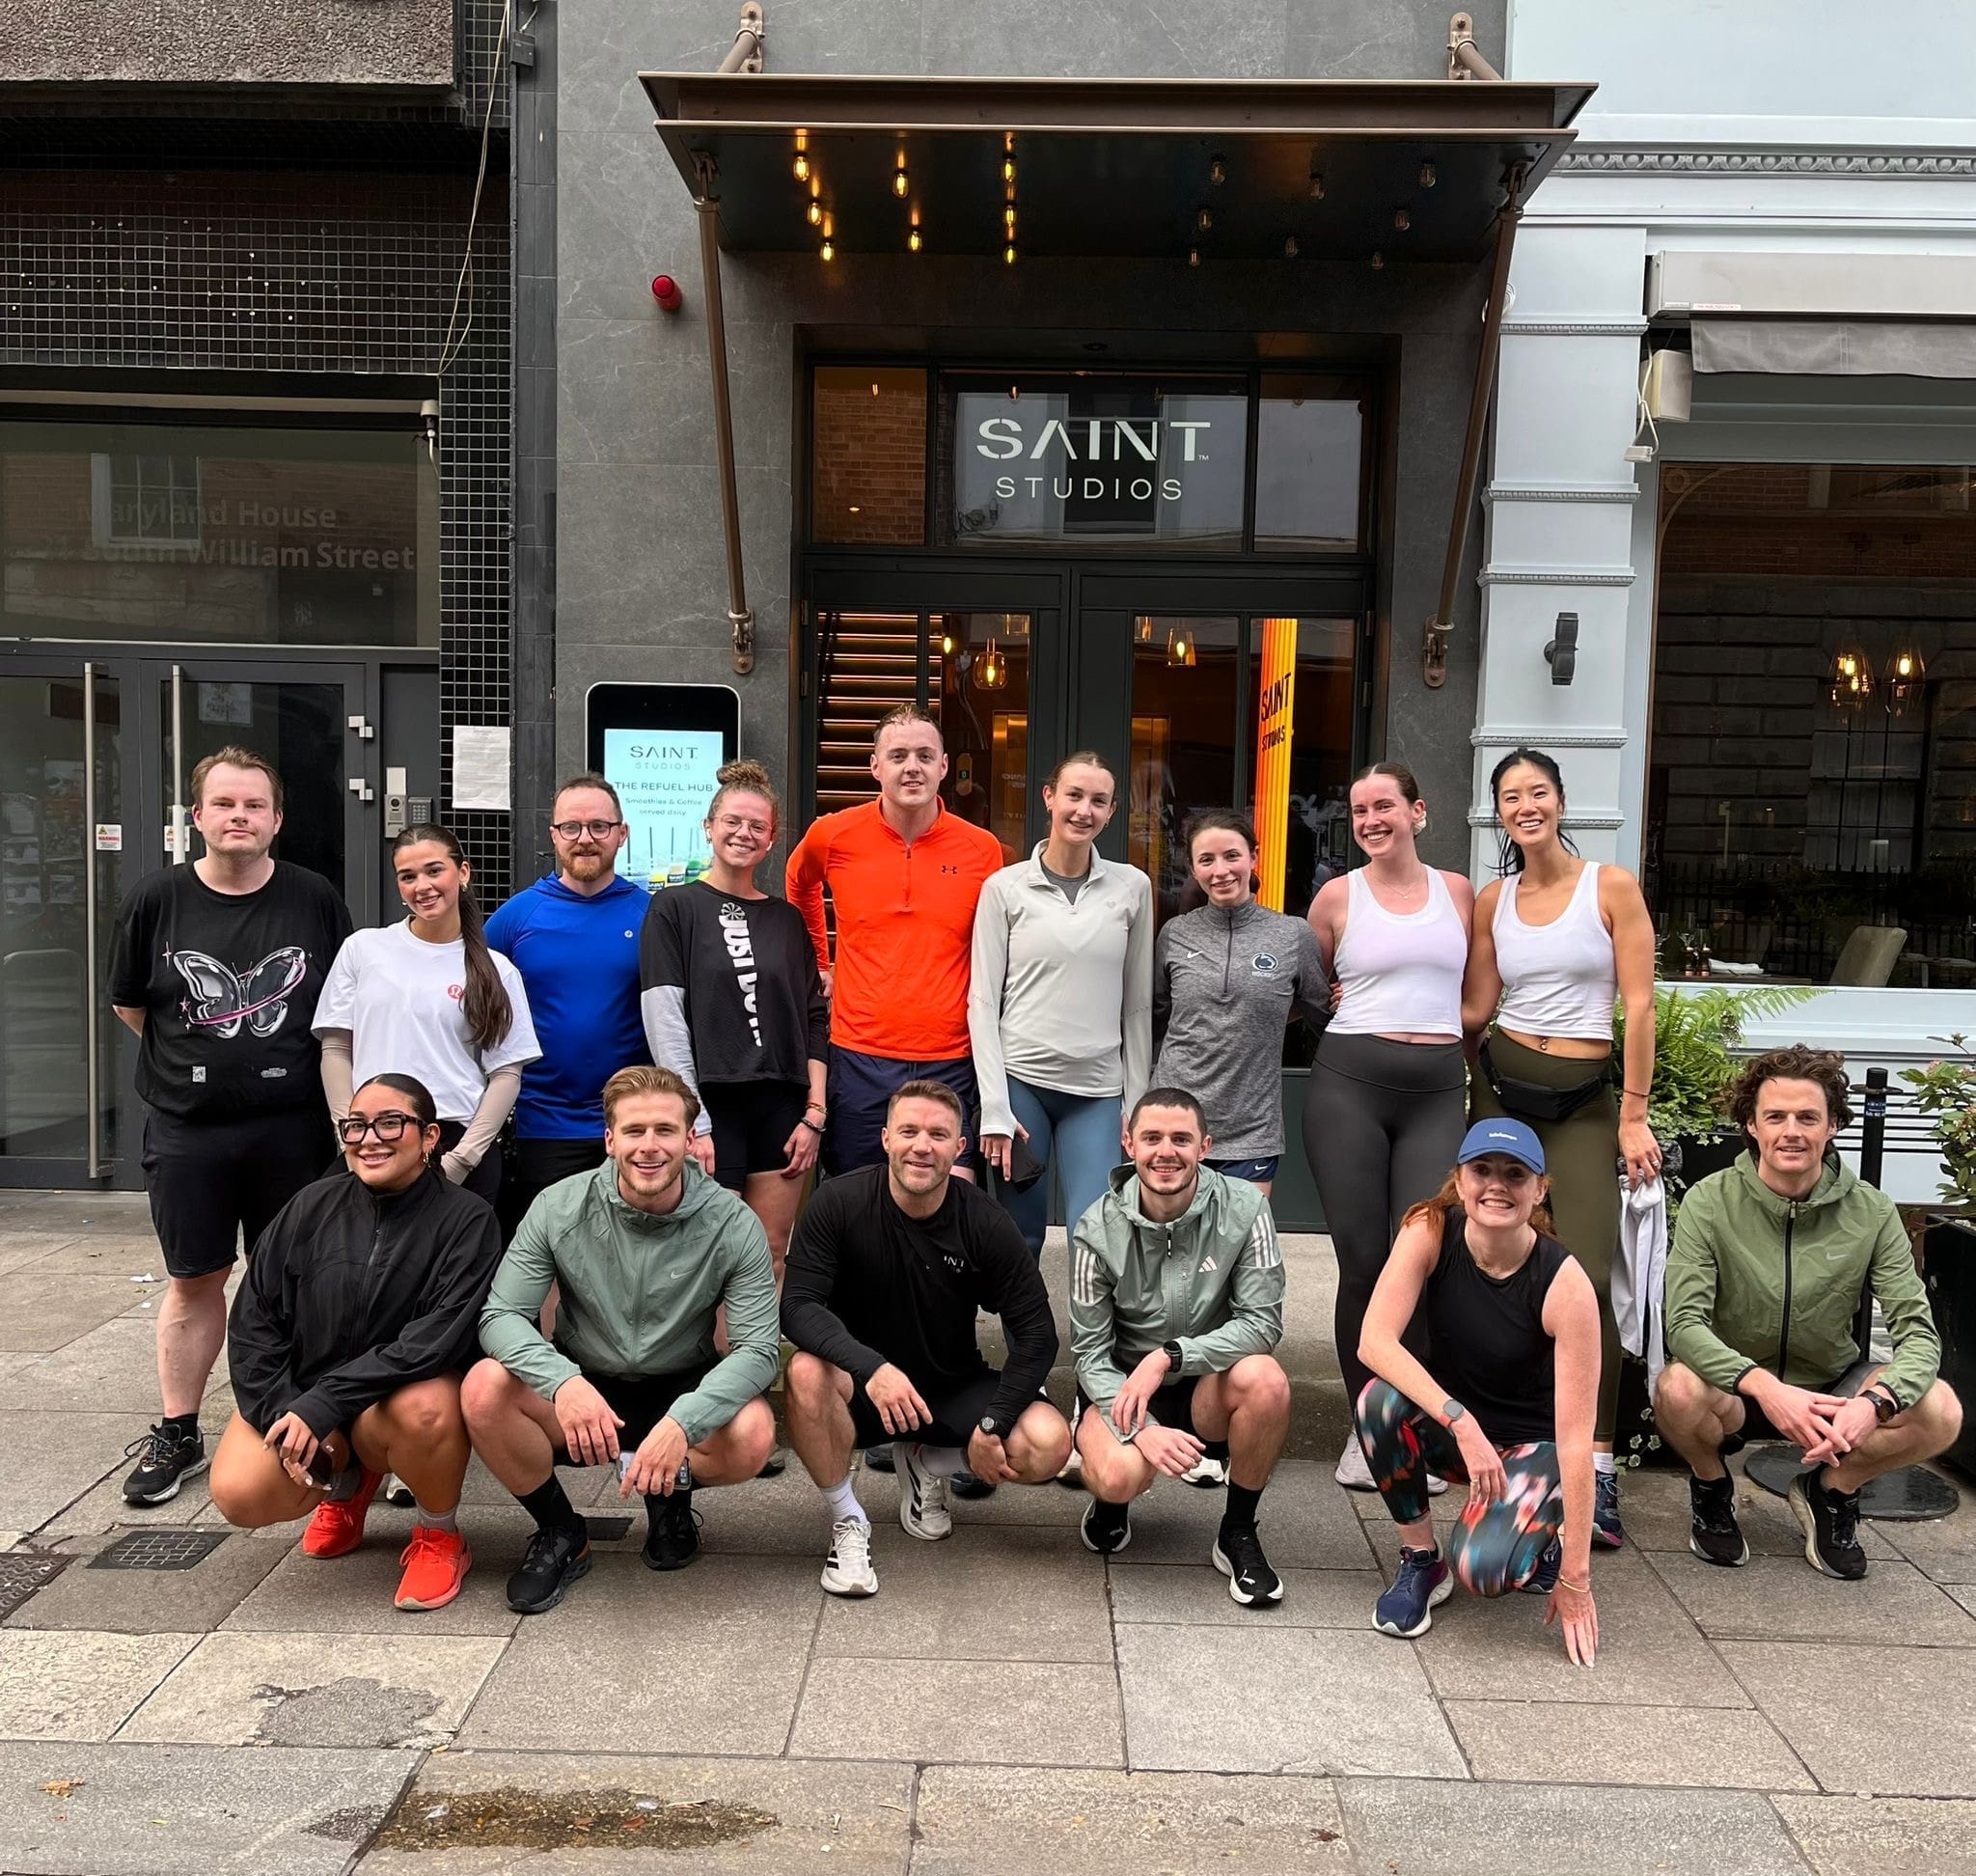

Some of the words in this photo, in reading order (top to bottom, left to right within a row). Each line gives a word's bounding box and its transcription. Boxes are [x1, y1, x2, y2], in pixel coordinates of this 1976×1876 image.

[976, 418, 1211, 461] SAINT
[996, 477, 1182, 501] STUDIOS
[238, 501, 337, 529] House
[186, 538, 309, 568] William
[316, 541, 415, 569] Street
[1261, 671, 1292, 722] SAINT
[630, 745, 699, 759] SAINT
[635, 761, 691, 770] STUDIOS
[615, 782, 638, 790] THE
[641, 782, 685, 791] REFUEL
[688, 784, 713, 792] HUB
